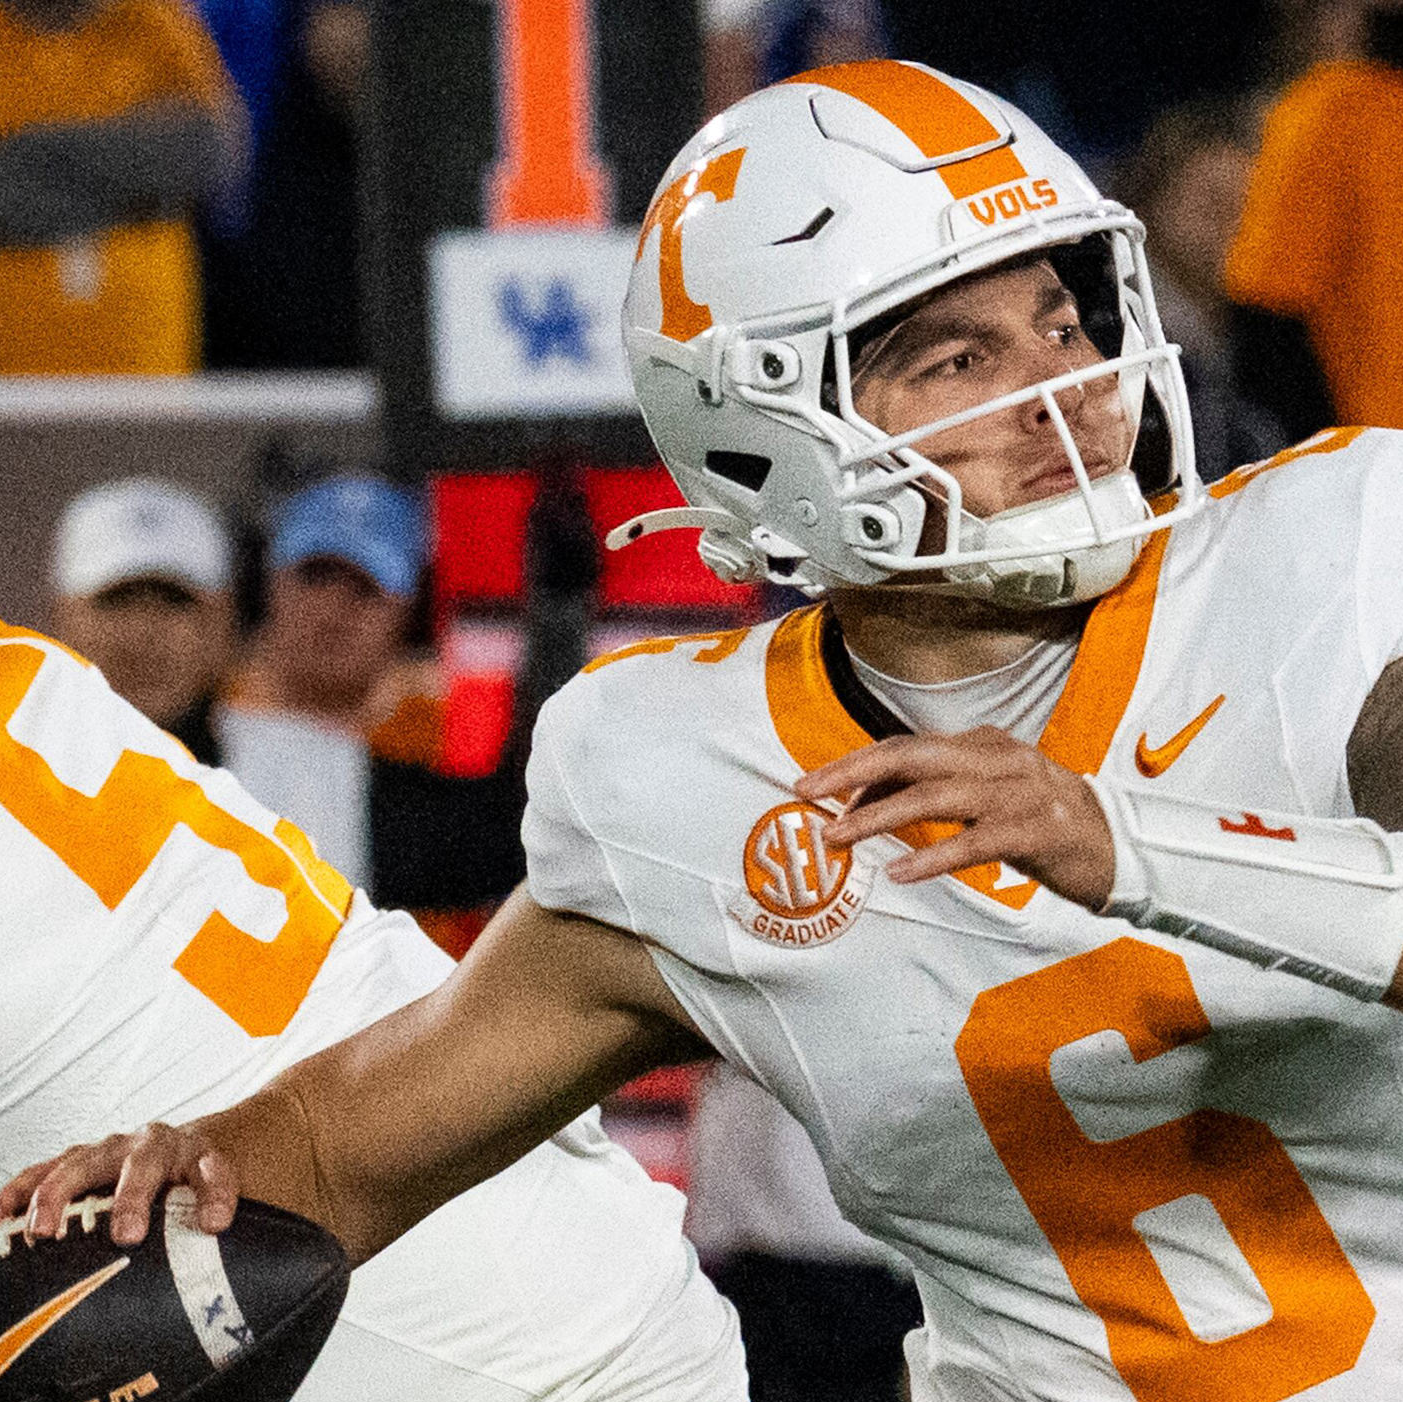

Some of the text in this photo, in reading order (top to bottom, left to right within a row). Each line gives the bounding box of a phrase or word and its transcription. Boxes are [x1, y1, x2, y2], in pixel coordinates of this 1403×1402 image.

[967, 178, 1058, 228] VOLS
[635, 145, 749, 343] T
[753, 889, 861, 945] GRADUATE
